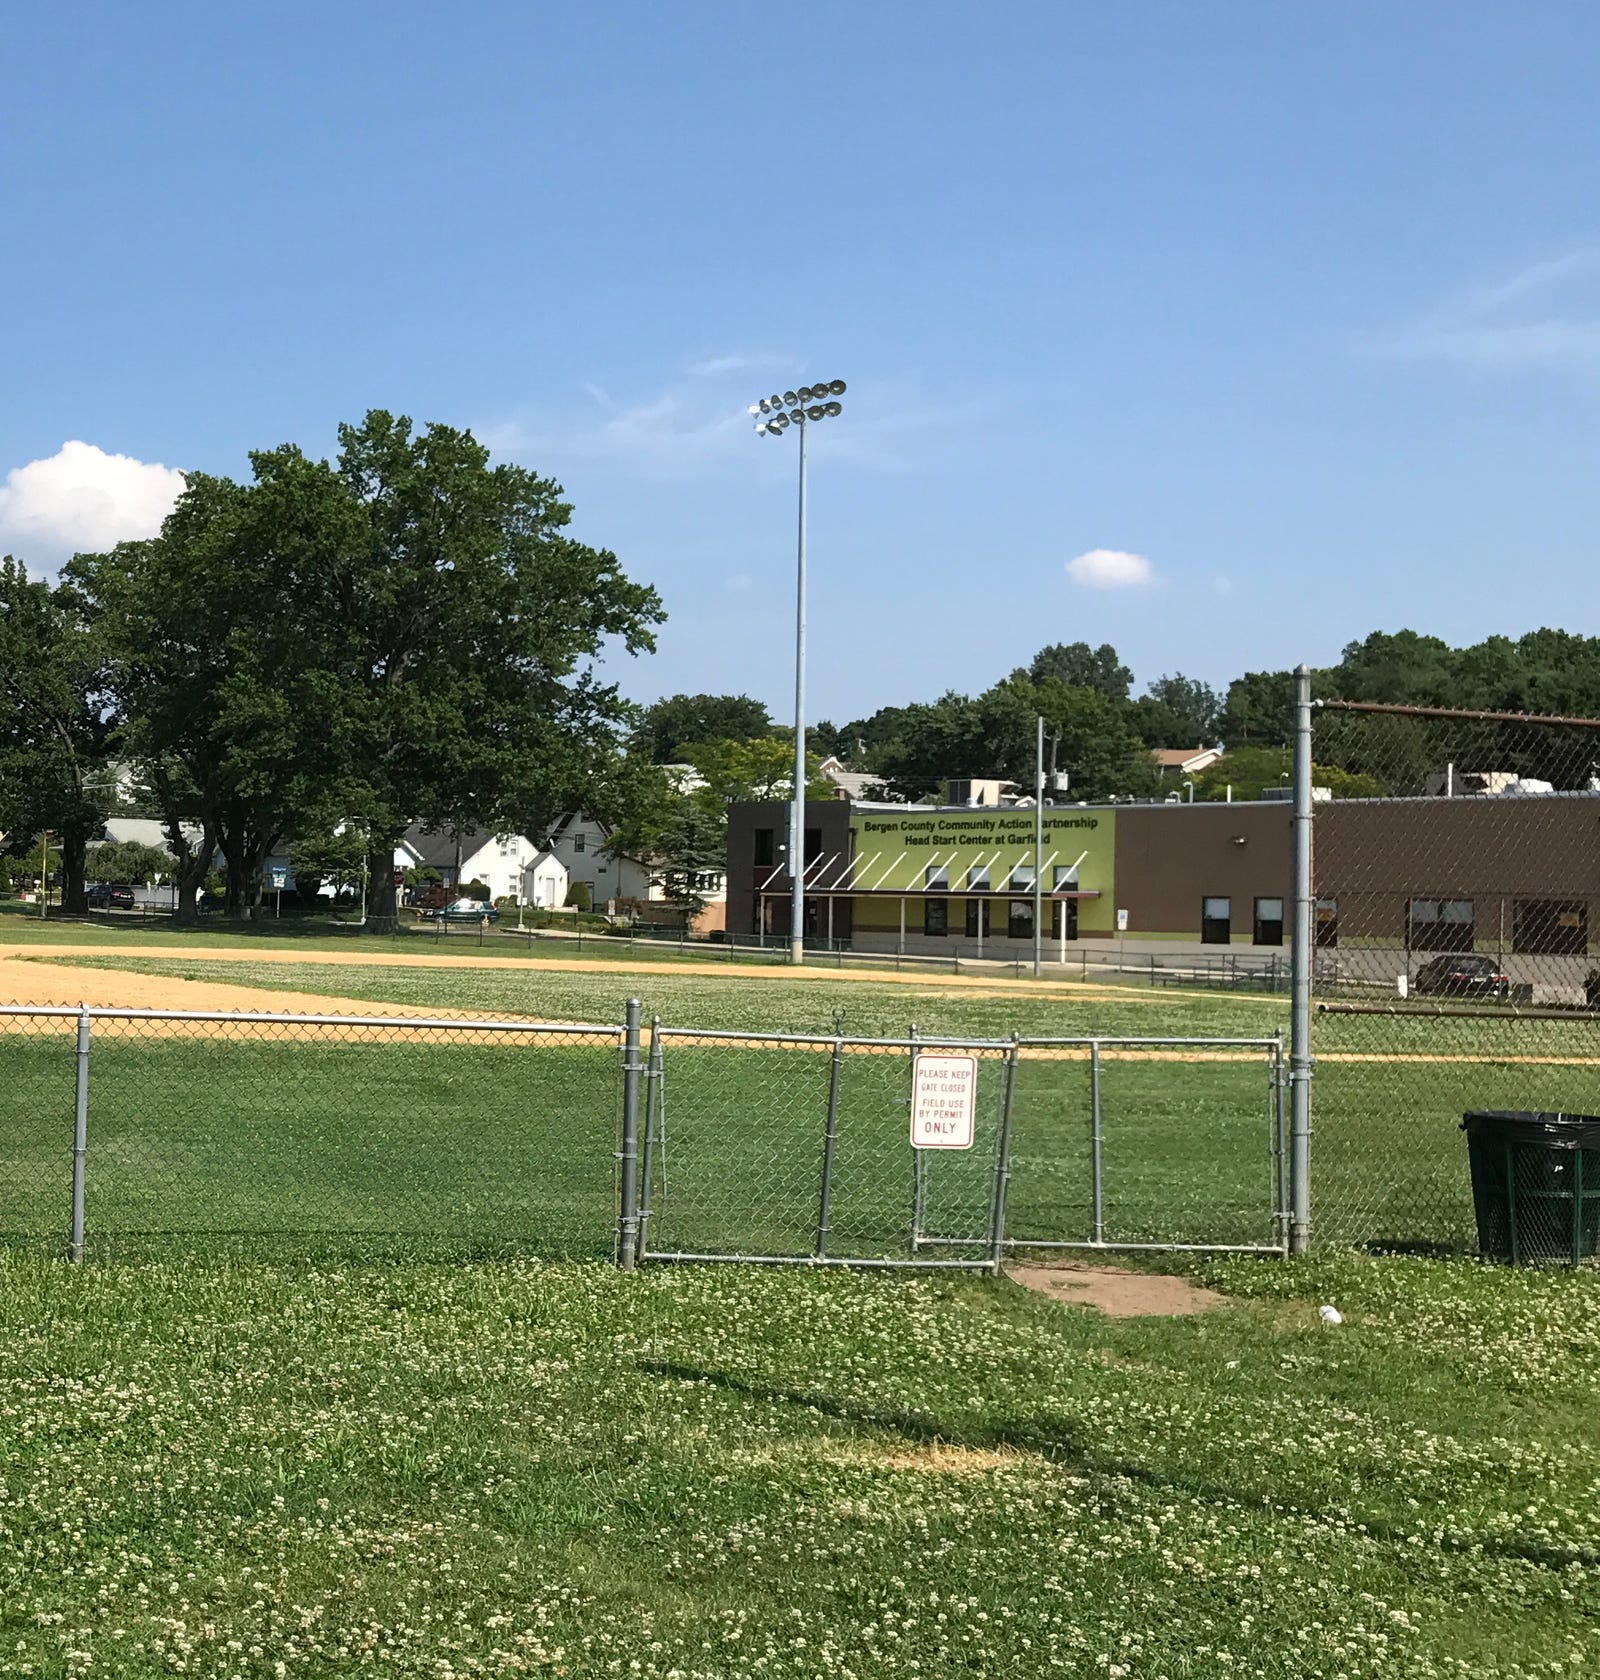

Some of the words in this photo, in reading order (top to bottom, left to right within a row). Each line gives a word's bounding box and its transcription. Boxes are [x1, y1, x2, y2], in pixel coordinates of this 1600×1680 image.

[864, 821, 898, 833] Bergen
[900, 820, 935, 832] County
[938, 819, 995, 832] Community
[998, 818, 1032, 829] Action
[1035, 817, 1098, 830] artnership
[905, 836, 930, 845] Head
[932, 835, 956, 845] Start
[958, 834, 992, 845] Center
[995, 835, 1005, 844] at
[919, 1069, 949, 1079] PLEASE
[951, 1070, 971, 1079] KEEP
[921, 1083, 937, 1092] GATE
[940, 1084, 966, 1093] CLOSED
[922, 1098, 945, 1108] FIELD
[948, 1100, 964, 1108] USE
[919, 1110, 930, 1118] BY
[933, 1110, 963, 1118] PERMIT
[924, 1122, 956, 1134] ONLY
